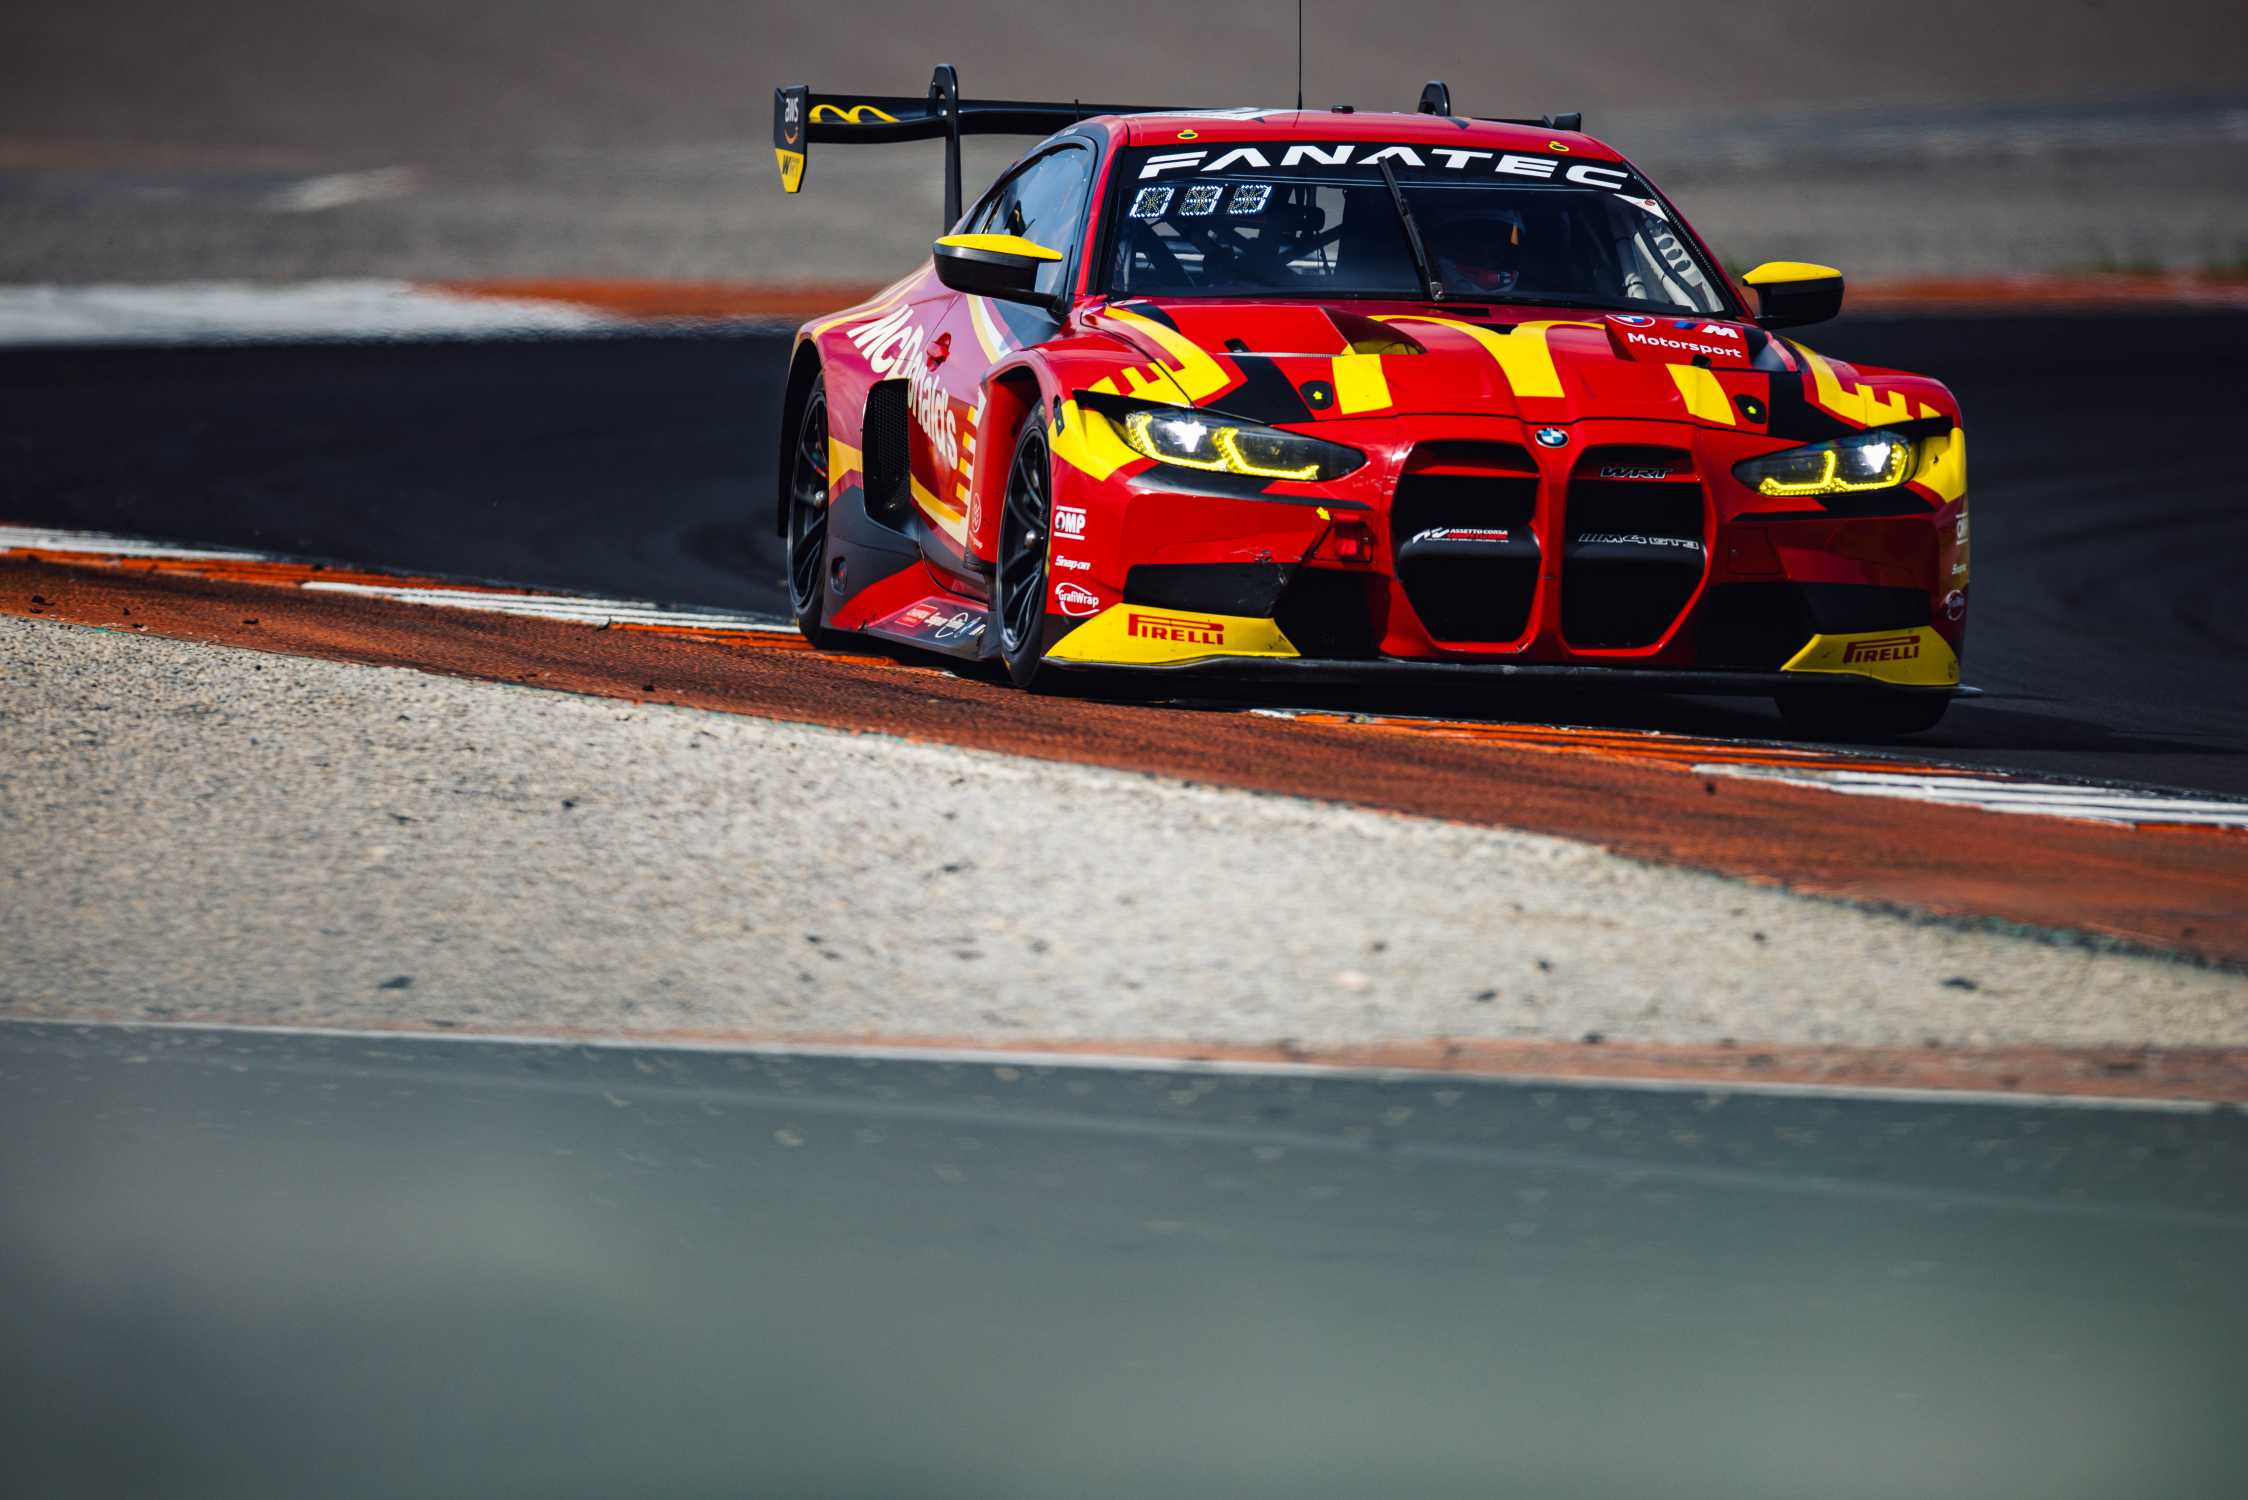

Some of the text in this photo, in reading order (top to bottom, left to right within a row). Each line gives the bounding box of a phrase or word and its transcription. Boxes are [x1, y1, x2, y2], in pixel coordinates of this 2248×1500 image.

[784, 97, 800, 123] aws
[1137, 145, 1628, 190] FANATEC
[1626, 332, 1743, 358] Motorsport
[846, 303, 958, 470] McDonald's
[1054, 511, 1087, 534] OMP
[1055, 555, 1091, 571] Snap-on
[1058, 589, 1099, 608] GrafiWrap
[1128, 613, 1224, 646] PIRELLI
[1842, 635, 1921, 664] PIRELLI
